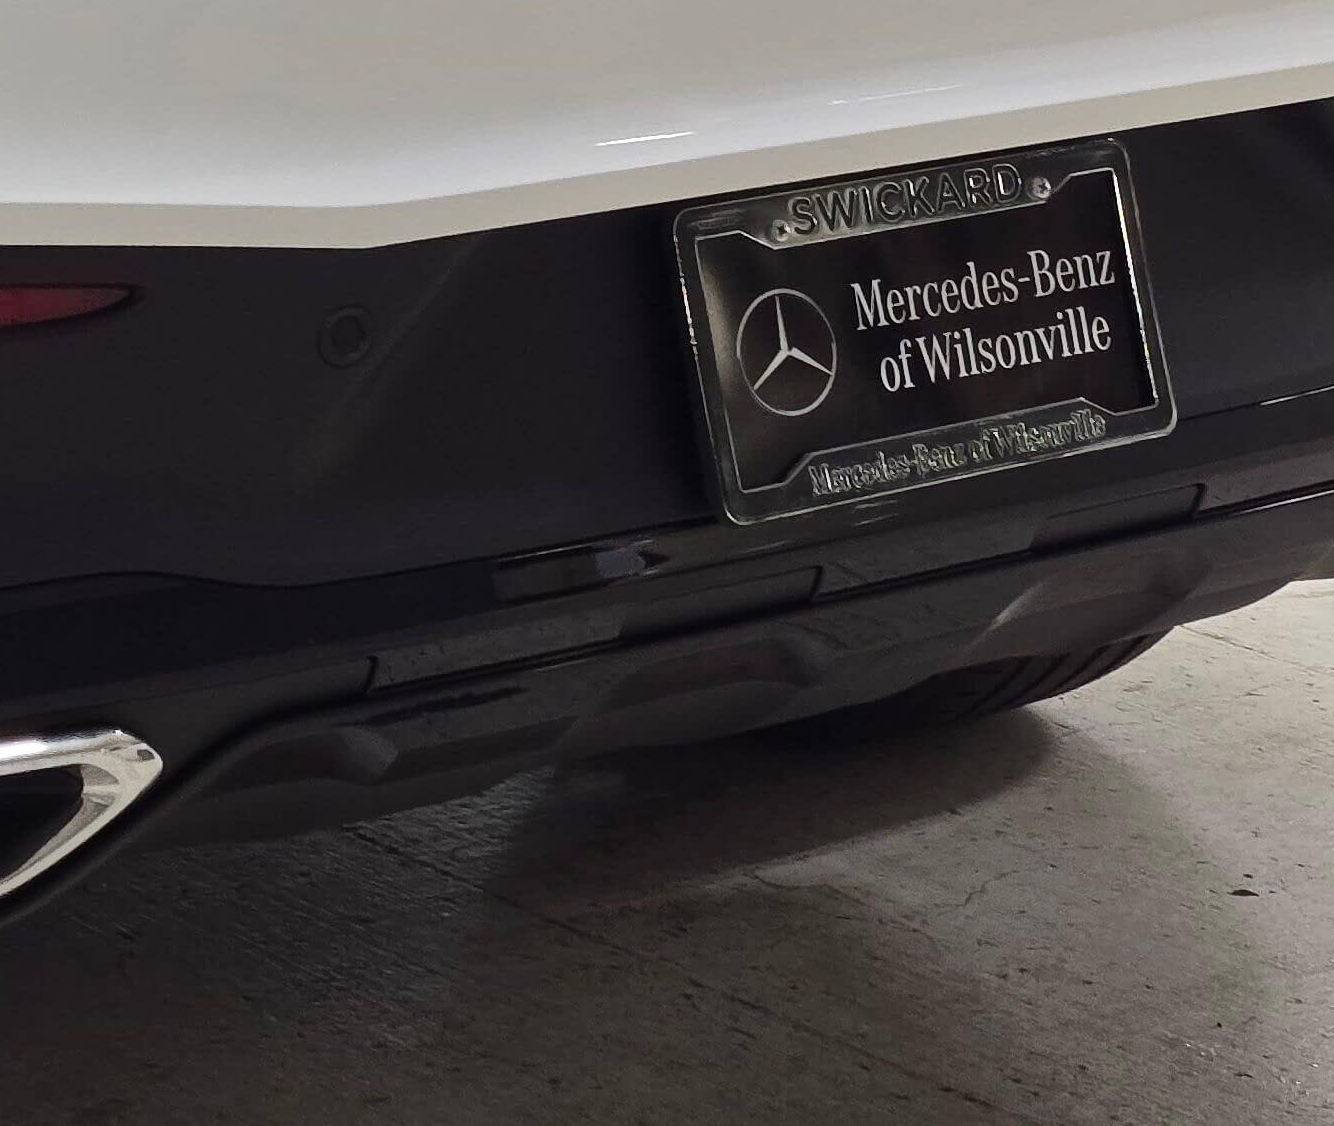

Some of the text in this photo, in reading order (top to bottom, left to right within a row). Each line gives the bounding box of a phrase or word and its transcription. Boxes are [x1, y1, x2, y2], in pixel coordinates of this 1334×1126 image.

[788, 163, 1023, 235] SWICKARD
[850, 249, 1116, 331] Mercedes-Benz
[880, 306, 1113, 392] of Wilsonville
[808, 408, 1106, 496] Mercedes-Benz of Wilsonville
